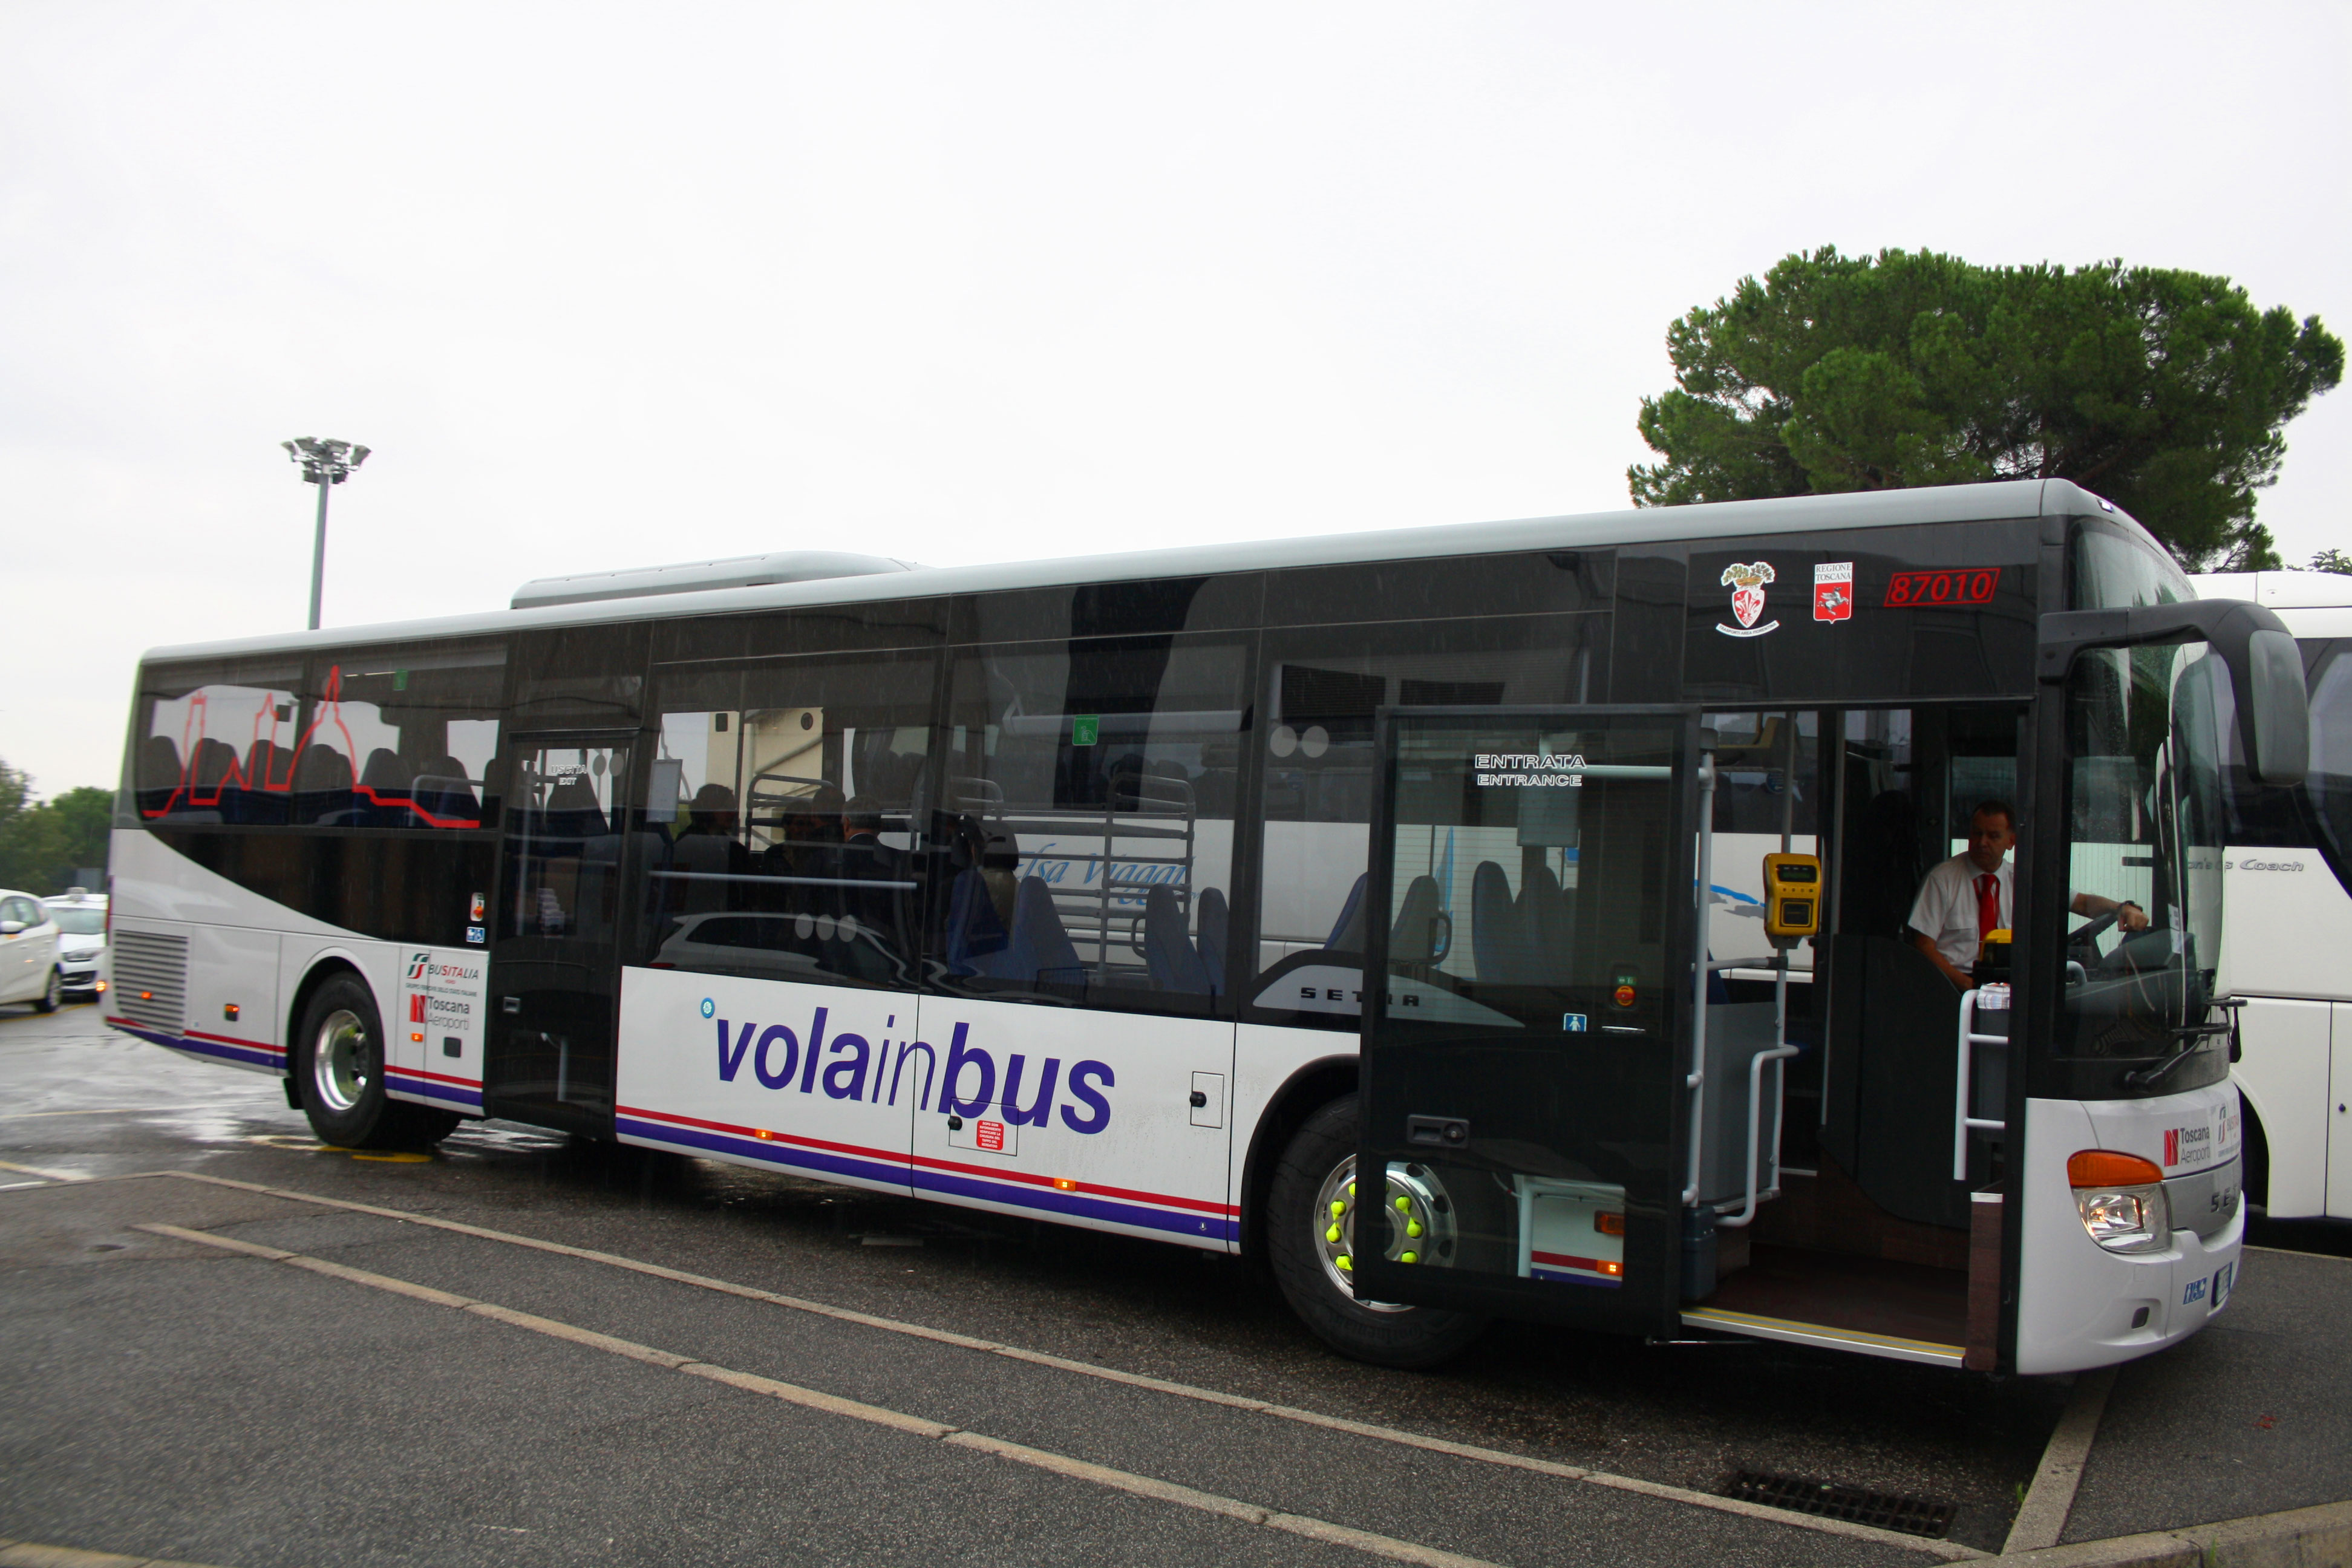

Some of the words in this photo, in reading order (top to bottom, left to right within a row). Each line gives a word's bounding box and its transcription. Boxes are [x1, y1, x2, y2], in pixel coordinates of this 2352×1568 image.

[1815, 563, 1852, 573] REGIONE
[1815, 572, 1851, 581] TOSCANA
[1890, 572, 1990, 602] 87010
[552, 765, 587, 774] USCITA
[1475, 754, 1587, 769] ENTRATA
[1477, 774, 1583, 786] ENTRANCE
[2239, 858, 2304, 871] Coach
[428, 964, 479, 979] BUSITALIA
[428, 996, 470, 1014] Toscana
[1301, 987, 1419, 1007] SETA
[426, 1012, 469, 1031] Aeroporti
[717, 1007, 1116, 1135] volainbus
[2180, 1126, 2210, 1145] Toscana
[2180, 1146, 2210, 1165] Aeroporti
